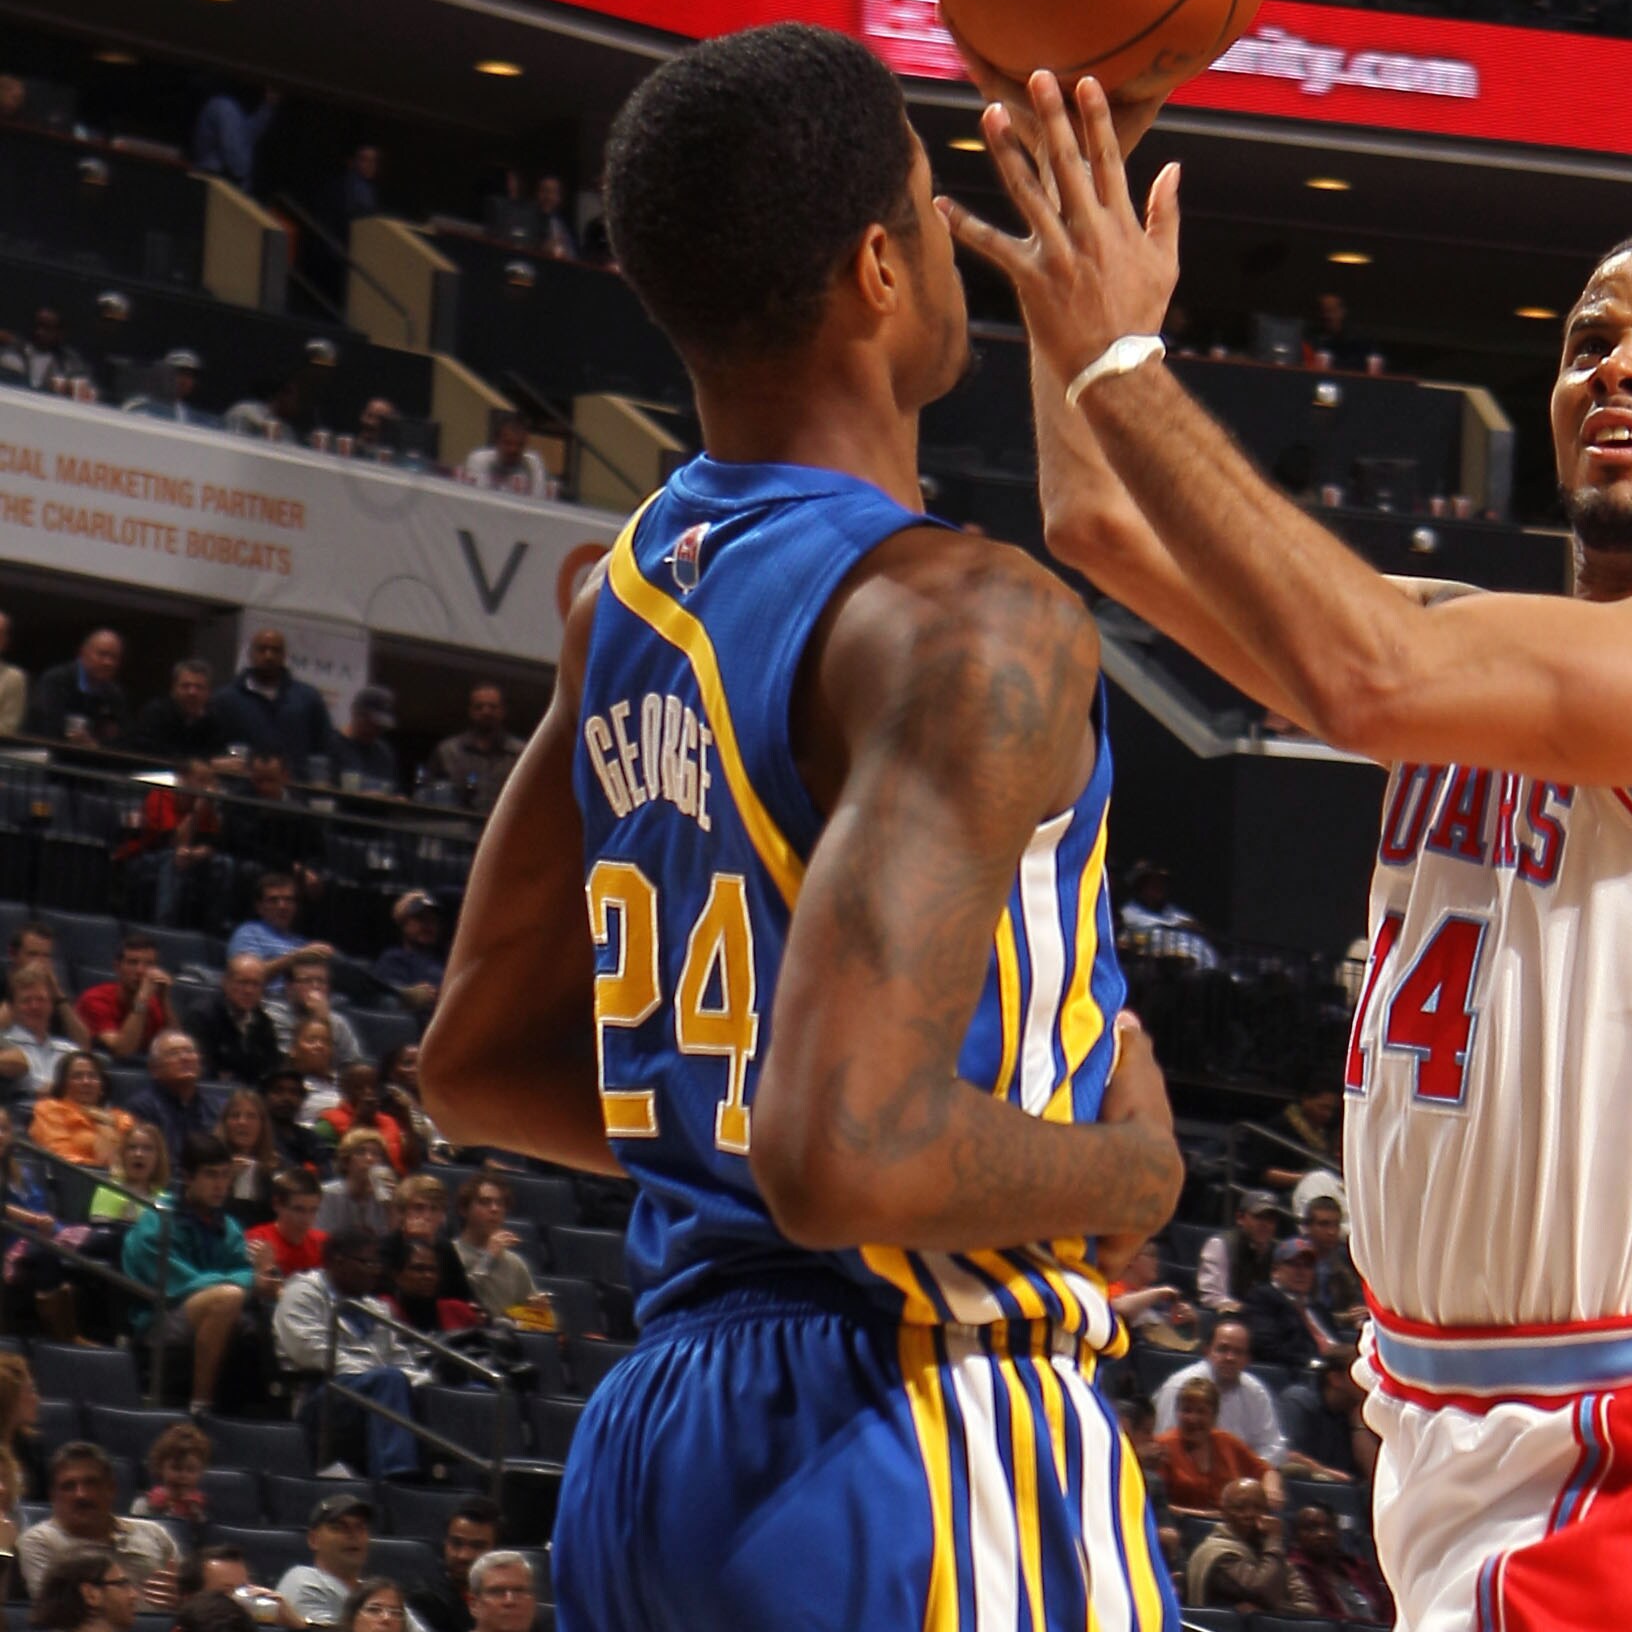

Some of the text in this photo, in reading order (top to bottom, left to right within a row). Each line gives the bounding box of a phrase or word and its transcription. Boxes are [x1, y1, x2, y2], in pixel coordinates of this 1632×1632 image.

[41, 499, 179, 555] CHARLOTTE
[186, 527, 292, 576] BOBCATS
[56, 453, 194, 509] MARKETING
[201, 483, 305, 529] PARTNER
[585, 692, 713, 833] GEORGE
[585, 859, 760, 1157] 24
[1343, 909, 1489, 1108] 14
